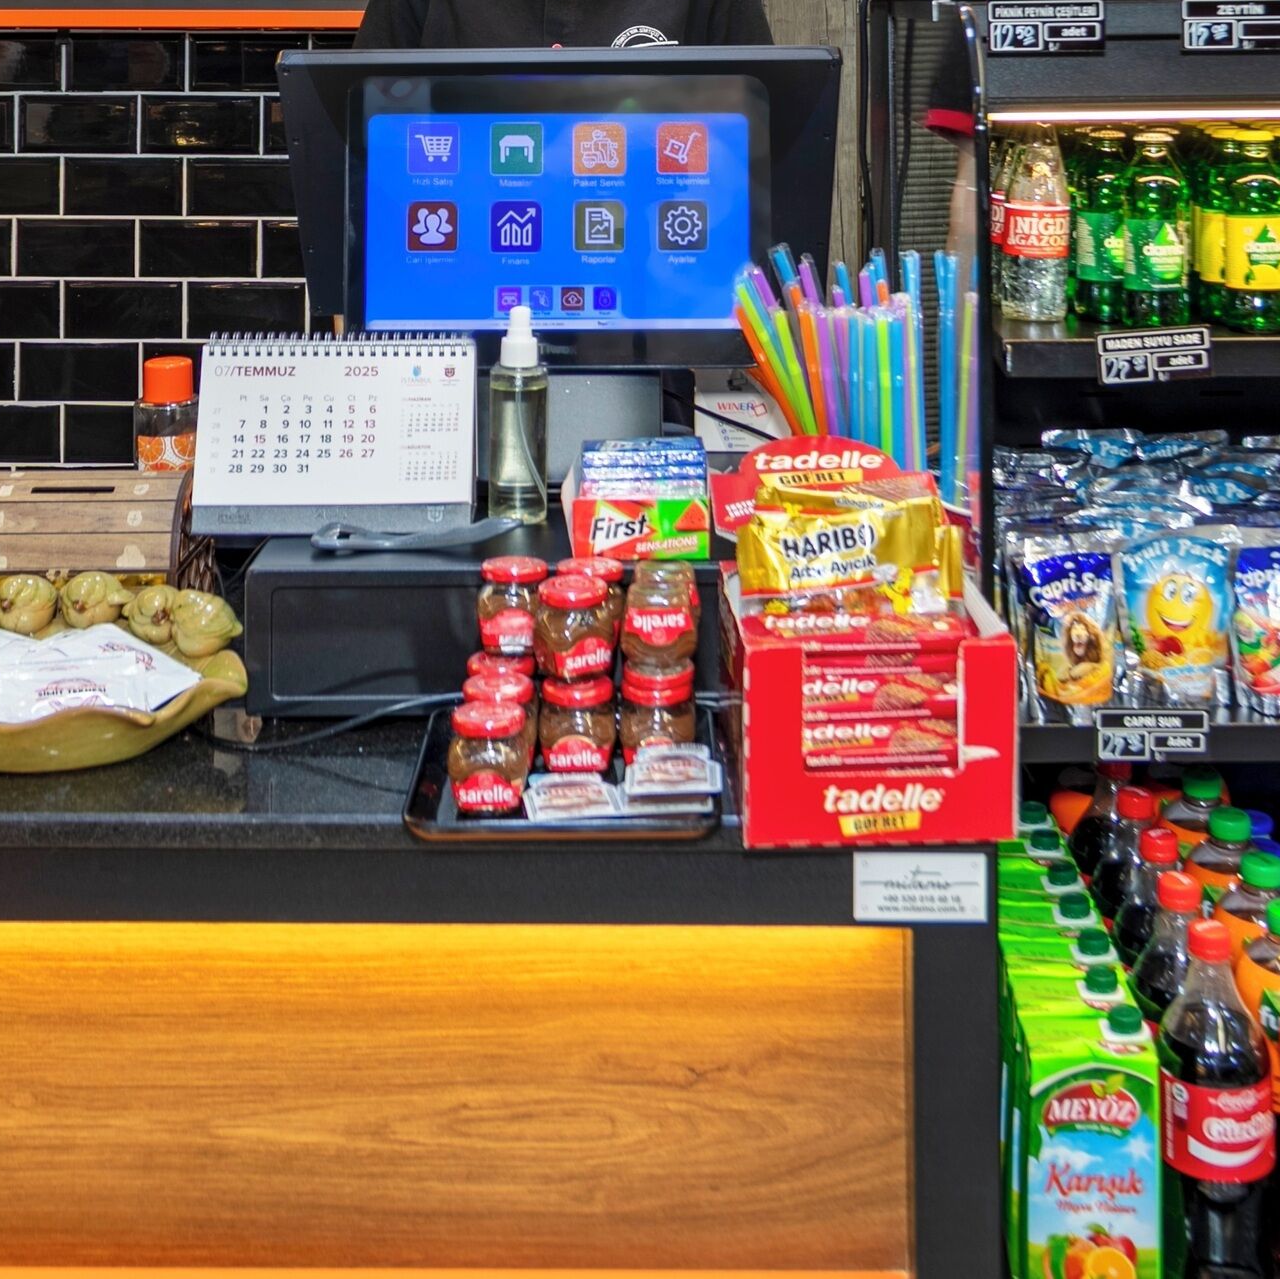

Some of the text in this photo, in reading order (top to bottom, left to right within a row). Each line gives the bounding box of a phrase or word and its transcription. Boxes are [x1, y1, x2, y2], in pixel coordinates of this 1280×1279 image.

[995, 4, 1097, 18] PİKNİK PEYNİR ÇEŞİTLERİ
[1216, 2, 1265, 15] ZEYTİN
[1061, 26, 1087, 37] adet
[573, 179, 597, 187] Paket
[581, 256, 616, 264] Raporlar
[668, 256, 697, 264] Ayarlar
[344, 366, 379, 377] 2025
[263, 405, 377, 415] 1 2 3 4 5 6
[717, 402, 754, 411] WINER
[239, 419, 246, 429] 7
[260, 419, 267, 429] 8
[282, 419, 290, 429] 9
[299, 419, 312, 429] 10
[323, 419, 333, 429] 11
[343, 419, 355, 429] 12
[365, 419, 376, 429] 13
[233, 434, 376, 444] 14 15 16 17 18 19 20
[231, 449, 375, 459] 21 22 23 24 25 26 27
[753, 451, 885, 470] tadelle
[228, 464, 310, 474] 28 29 30 31
[591, 513, 647, 542] First
[635, 535, 698, 553] SENSATIONS
[782, 523, 875, 559] HARIBO
[1123, 539, 1228, 570] Fruit Pack
[633, 613, 687, 632] sarelle
[765, 614, 870, 629] tadelle
[565, 648, 612, 671] sarelle
[802, 678, 877, 696] delle
[548, 750, 603, 768] sarelle
[458, 784, 514, 804] sarelle
[823, 783, 944, 813] tadelle
[1047, 1094, 1137, 1123] MEYÖZ
[1044, 1162, 1144, 1200] Karışık
